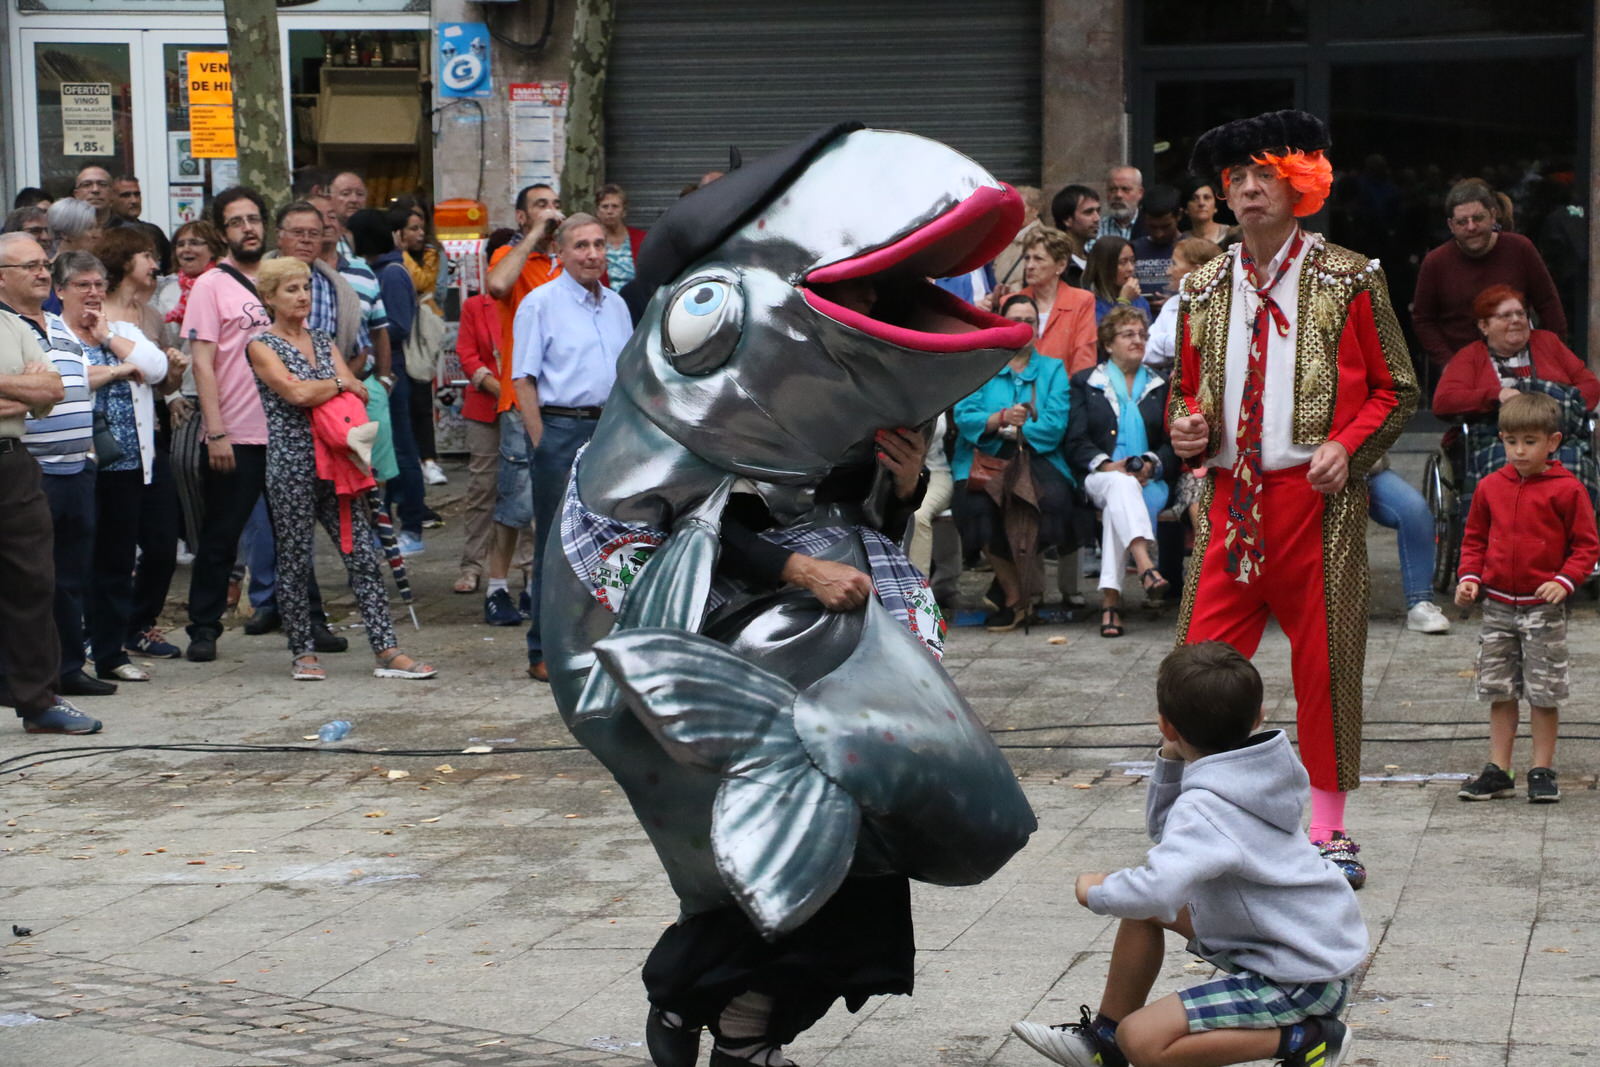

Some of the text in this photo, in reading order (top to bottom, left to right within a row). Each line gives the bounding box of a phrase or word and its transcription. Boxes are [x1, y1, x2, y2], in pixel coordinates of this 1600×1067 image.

[200, 63, 228, 72] VEN
[65, 86, 109, 95] OFERTÓN
[191, 81, 209, 91] DE
